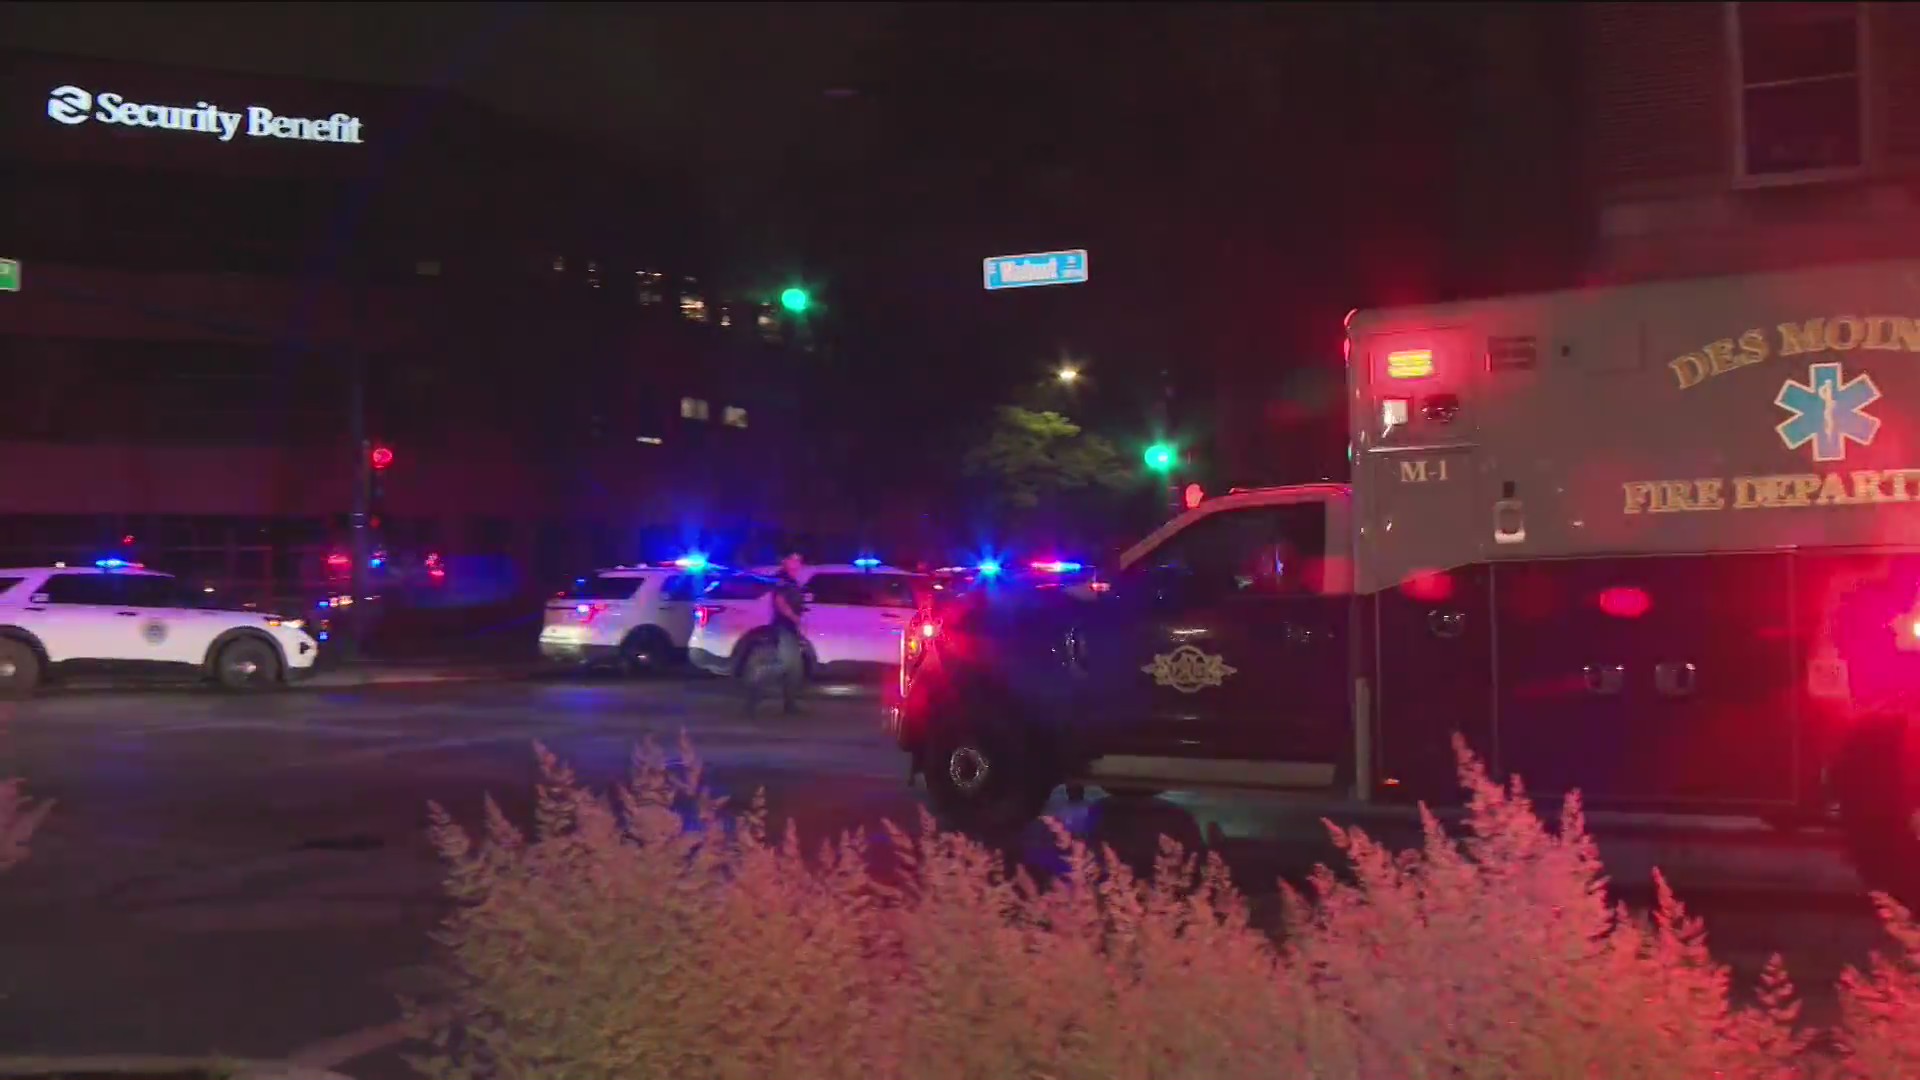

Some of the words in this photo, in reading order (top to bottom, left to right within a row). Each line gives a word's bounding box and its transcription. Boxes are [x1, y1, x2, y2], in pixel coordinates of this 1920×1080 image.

[96, 92, 242, 141] Security
[246, 106, 364, 143] Benefit
[1668, 328, 1768, 389] DES
[1401, 460, 1448, 482] M-1
[1622, 477, 1725, 514] FIRE
